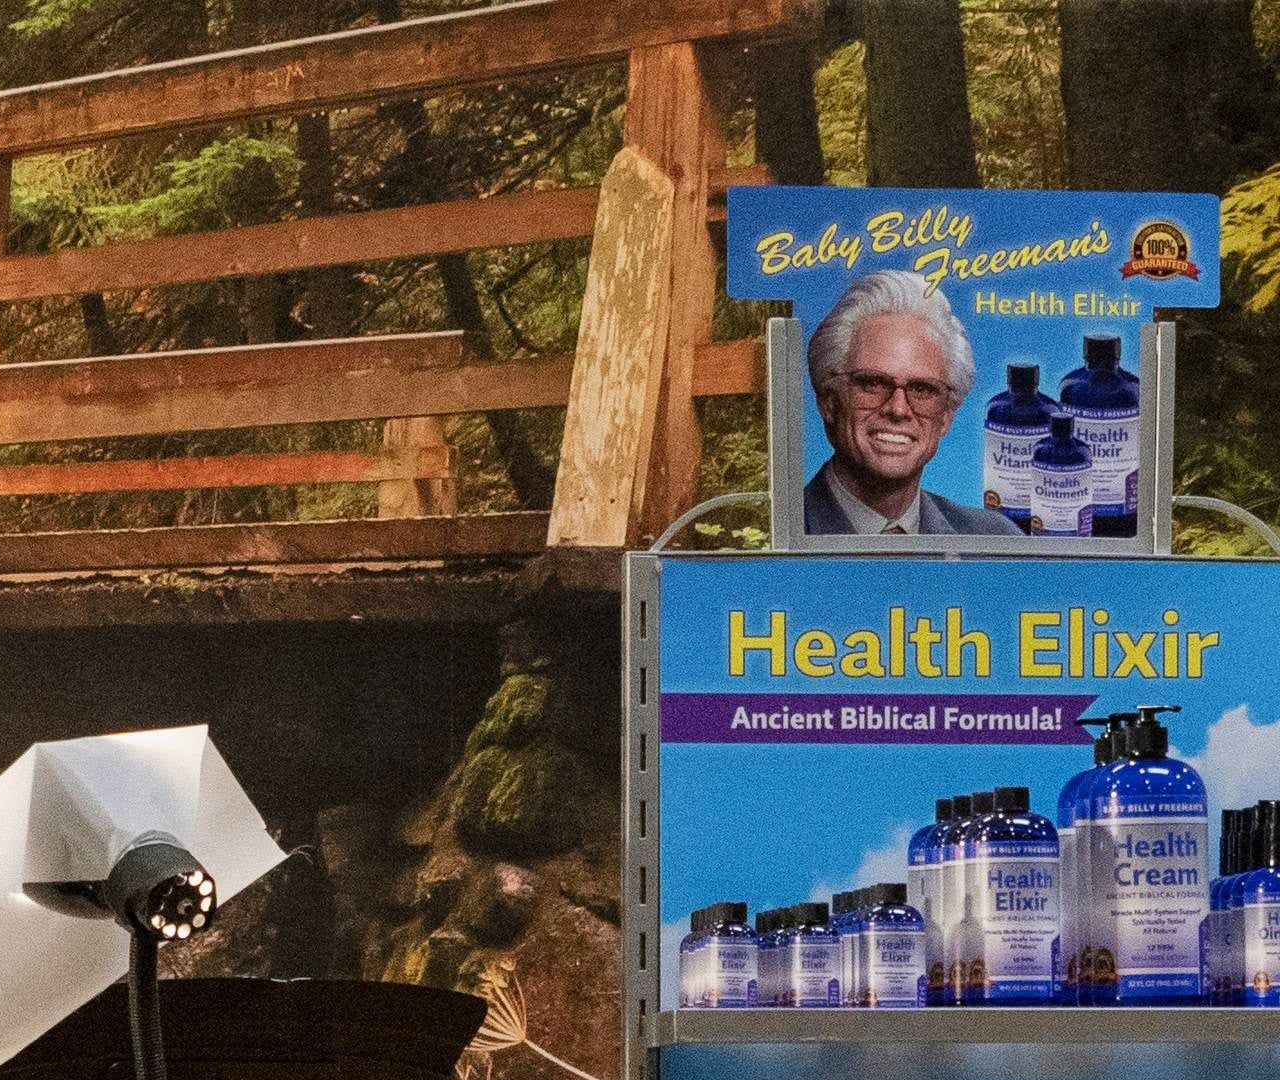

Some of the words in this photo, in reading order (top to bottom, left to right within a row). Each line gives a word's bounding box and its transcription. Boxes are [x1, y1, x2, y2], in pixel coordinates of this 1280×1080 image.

[756, 223, 863, 276] Baby
[866, 204, 973, 253] Billy
[1146, 239, 1176, 256] 100%
[912, 218, 1112, 299] Freeman's
[1131, 258, 1189, 271] GUARANTEED
[975, 291, 1065, 316] Health
[1072, 292, 1141, 317] Elixir
[1076, 427, 1129, 443] Health
[1000, 441, 1032, 456] Heal
[1034, 485, 1089, 499] Ointment
[1042, 476, 1081, 489] Health
[728, 606, 992, 678] Health
[1018, 606, 1219, 679] Elixir
[730, 706, 834, 730] Ancient
[841, 706, 936, 730] Biblical
[944, 706, 1063, 731] Formula!
[1127, 803, 1157, 813] BILLY
[1114, 831, 1199, 858] Health
[988, 868, 1053, 889] Health
[1114, 862, 1199, 887] Cream
[996, 889, 1049, 912] Elixir
[881, 950, 911, 963] Elixir
